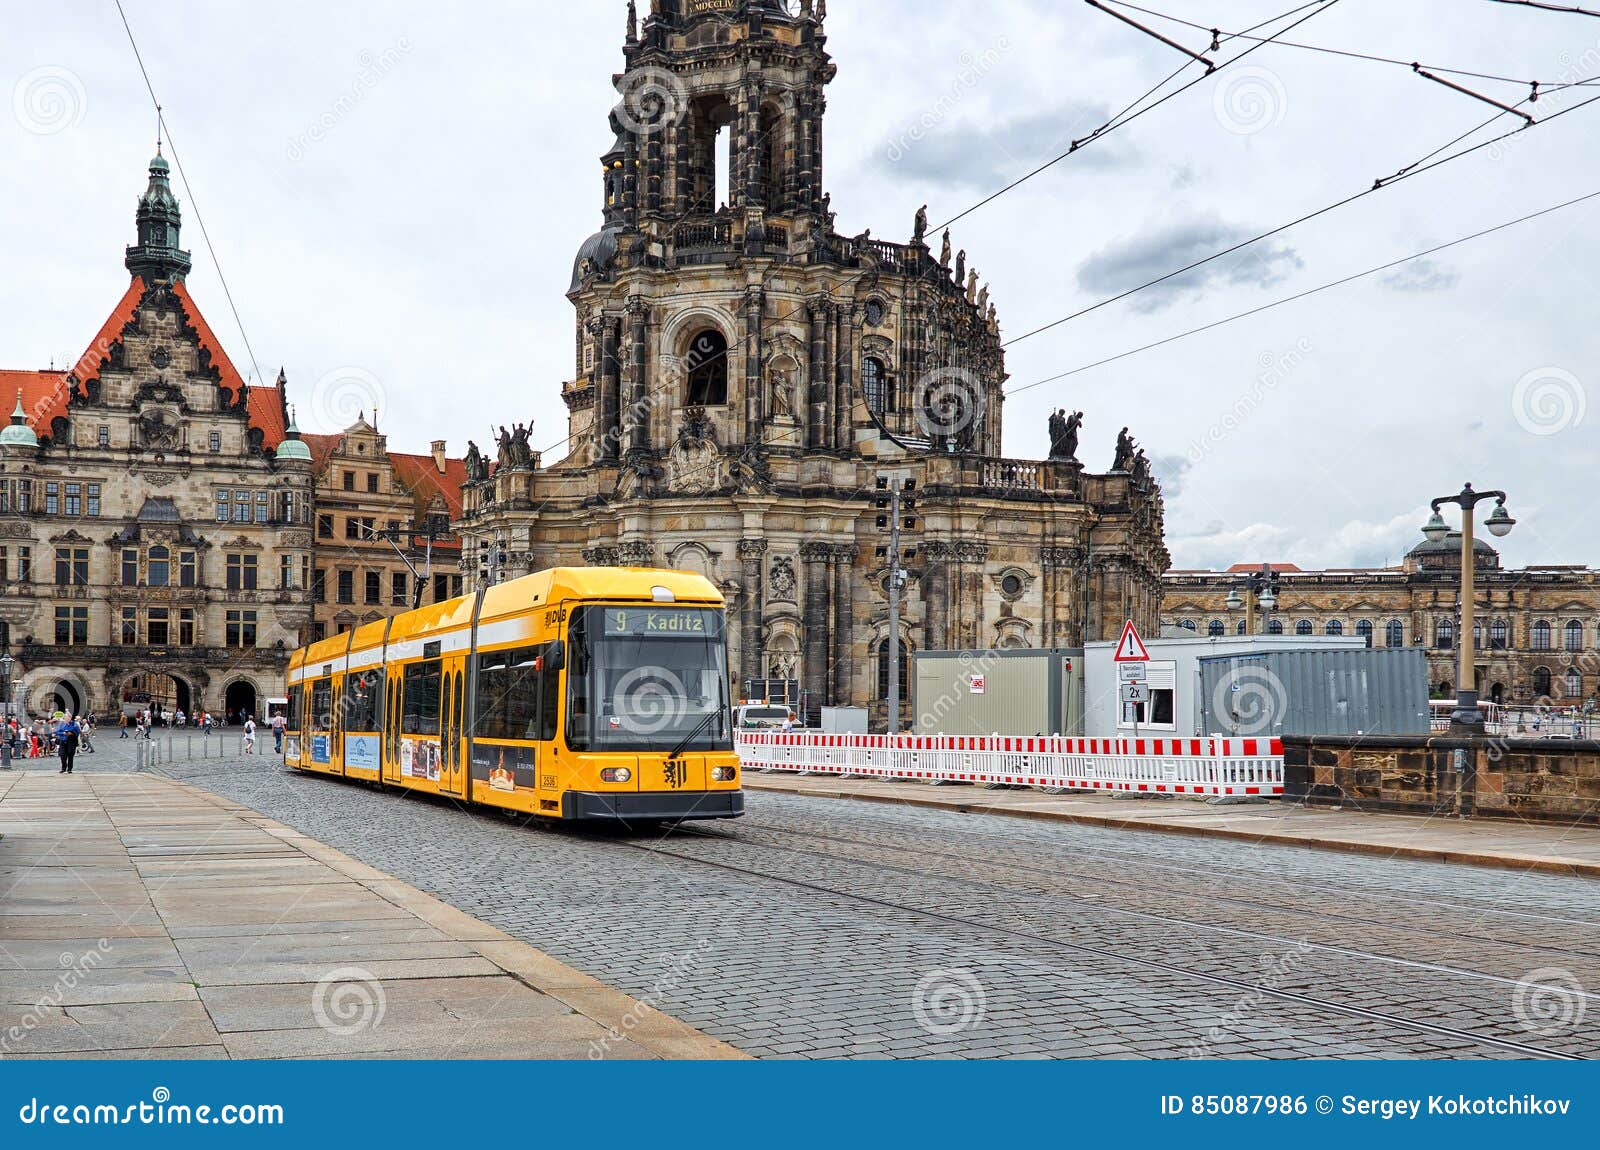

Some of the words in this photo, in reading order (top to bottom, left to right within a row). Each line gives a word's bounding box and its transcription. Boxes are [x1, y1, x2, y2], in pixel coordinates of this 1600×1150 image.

[616, 611, 627, 632] 9
[647, 613, 704, 631] Kaditz
[1129, 687, 1141, 699] 2x
